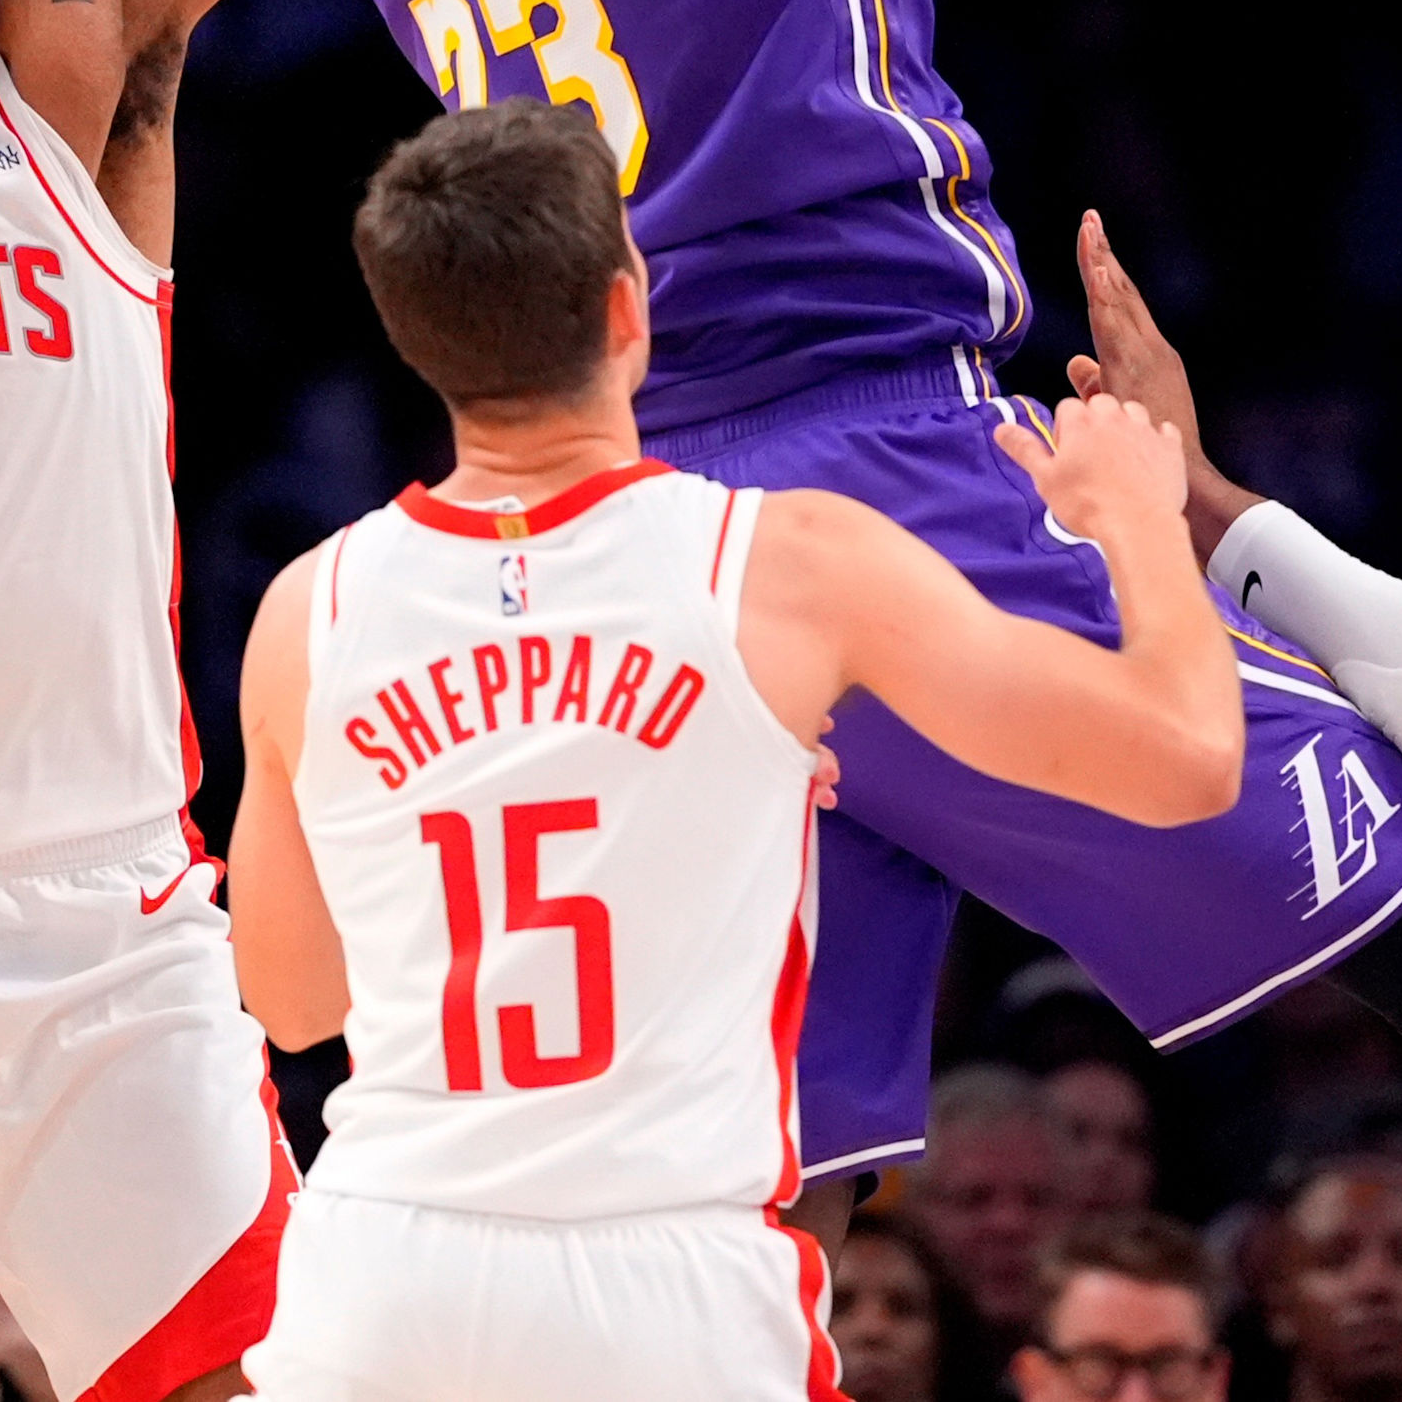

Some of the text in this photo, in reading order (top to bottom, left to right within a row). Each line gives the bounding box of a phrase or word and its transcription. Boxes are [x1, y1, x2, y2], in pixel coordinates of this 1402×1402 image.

[344, 635, 705, 791] SHEPPARD
[1279, 732, 1402, 922] LA
[419, 797, 615, 1093] 15
